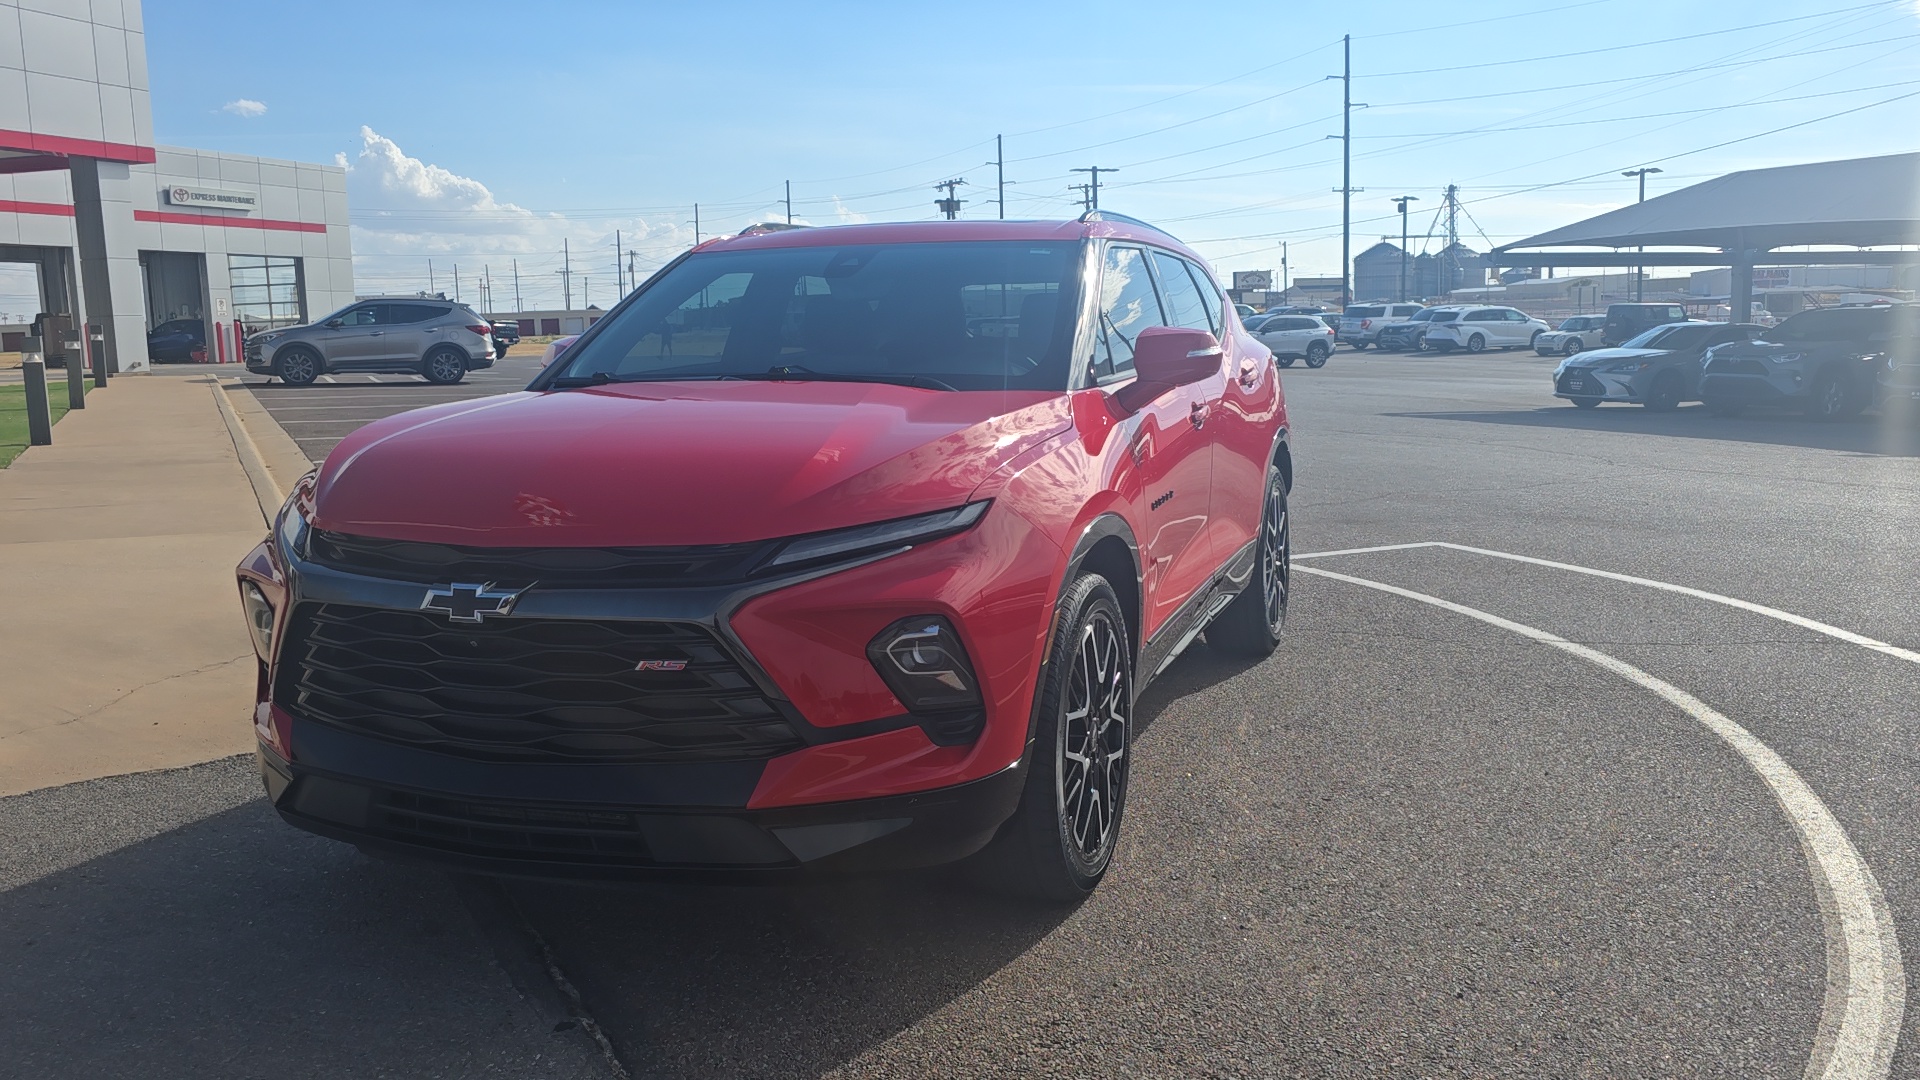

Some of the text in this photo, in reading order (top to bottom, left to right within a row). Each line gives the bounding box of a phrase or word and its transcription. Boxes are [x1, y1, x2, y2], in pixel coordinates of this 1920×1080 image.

[191, 192, 256, 205] EXPRESS MAINTENANCE
[635, 660, 688, 671] RS
